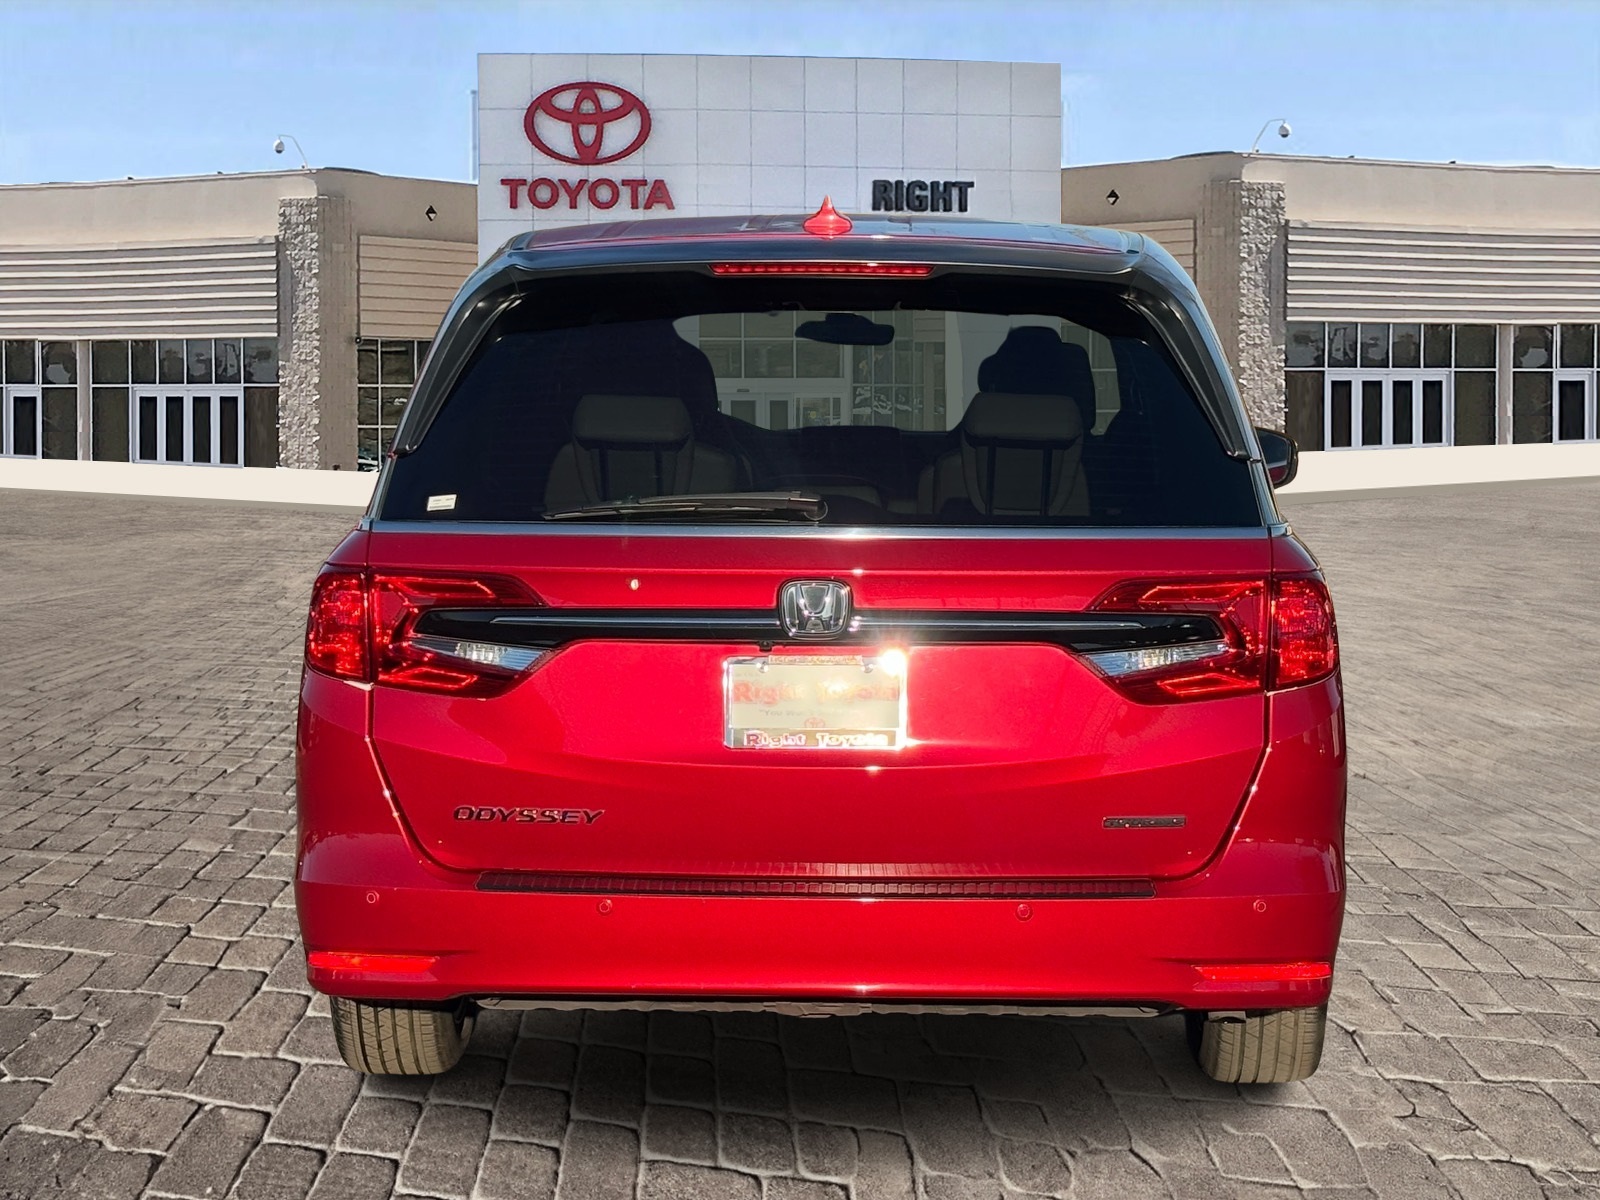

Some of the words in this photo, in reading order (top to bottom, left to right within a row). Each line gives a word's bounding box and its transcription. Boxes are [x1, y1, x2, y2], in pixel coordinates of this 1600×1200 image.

[500, 178, 675, 210] TOYOTA
[872, 179, 975, 213] RIGHT
[743, 730, 807, 748] Right
[453, 805, 606, 825] ODYSSEY
